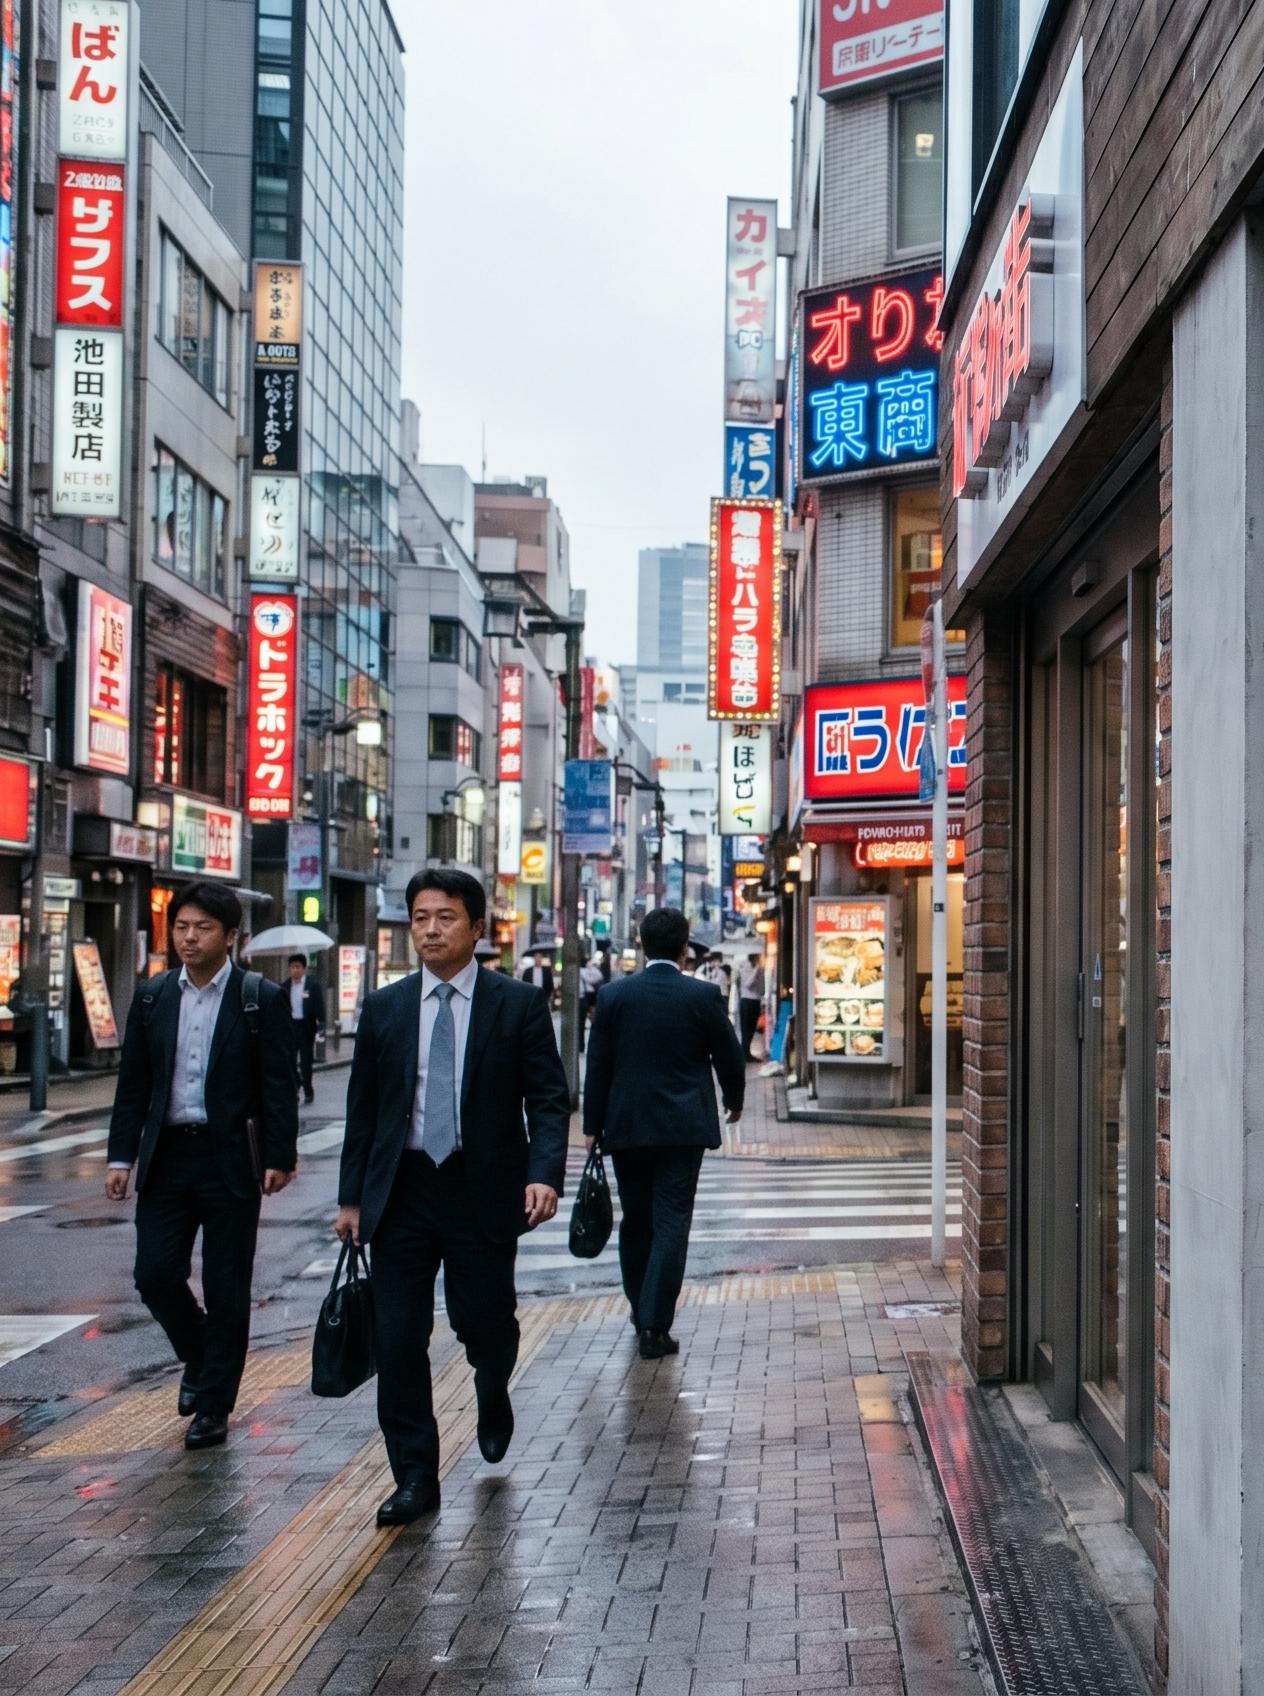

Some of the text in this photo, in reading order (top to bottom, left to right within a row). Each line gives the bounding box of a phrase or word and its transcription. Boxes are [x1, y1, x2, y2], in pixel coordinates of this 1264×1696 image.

[69, 22, 120, 104] ばん
[71, 338, 104, 462] 池田製店
